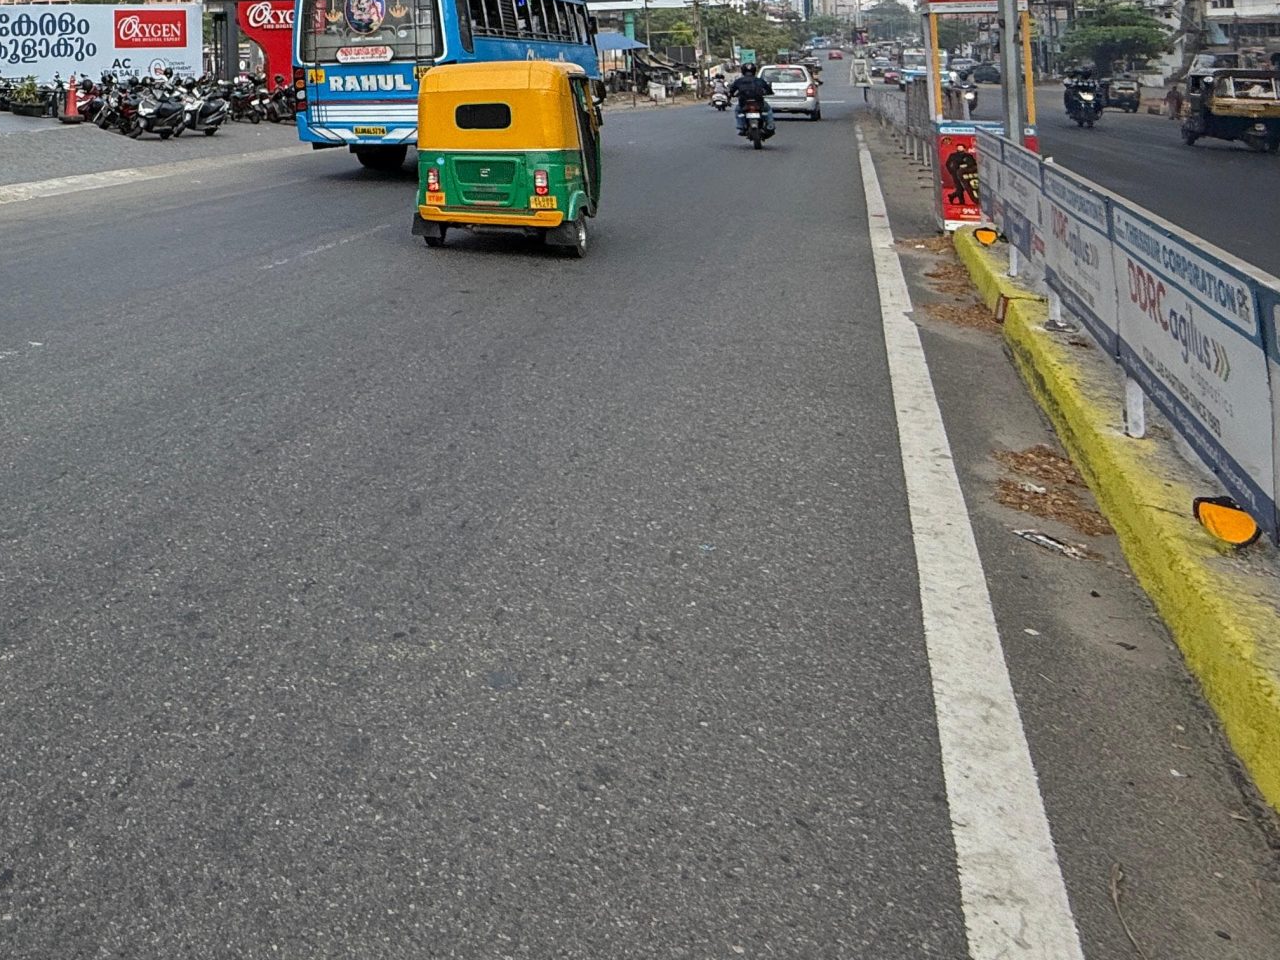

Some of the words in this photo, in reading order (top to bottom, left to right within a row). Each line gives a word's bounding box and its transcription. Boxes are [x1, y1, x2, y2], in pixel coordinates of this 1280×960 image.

[117, 15, 181, 40] OXYGEN
[112, 58, 131, 69] AC
[119, 69, 140, 77] SALE
[329, 74, 412, 92] RAHUL
[1125, 221, 1162, 264] THRISSUR
[1162, 245, 1237, 315] CORPORATION
[1127, 257, 1169, 332] DDRC
[1169, 302, 1212, 371] agilus
